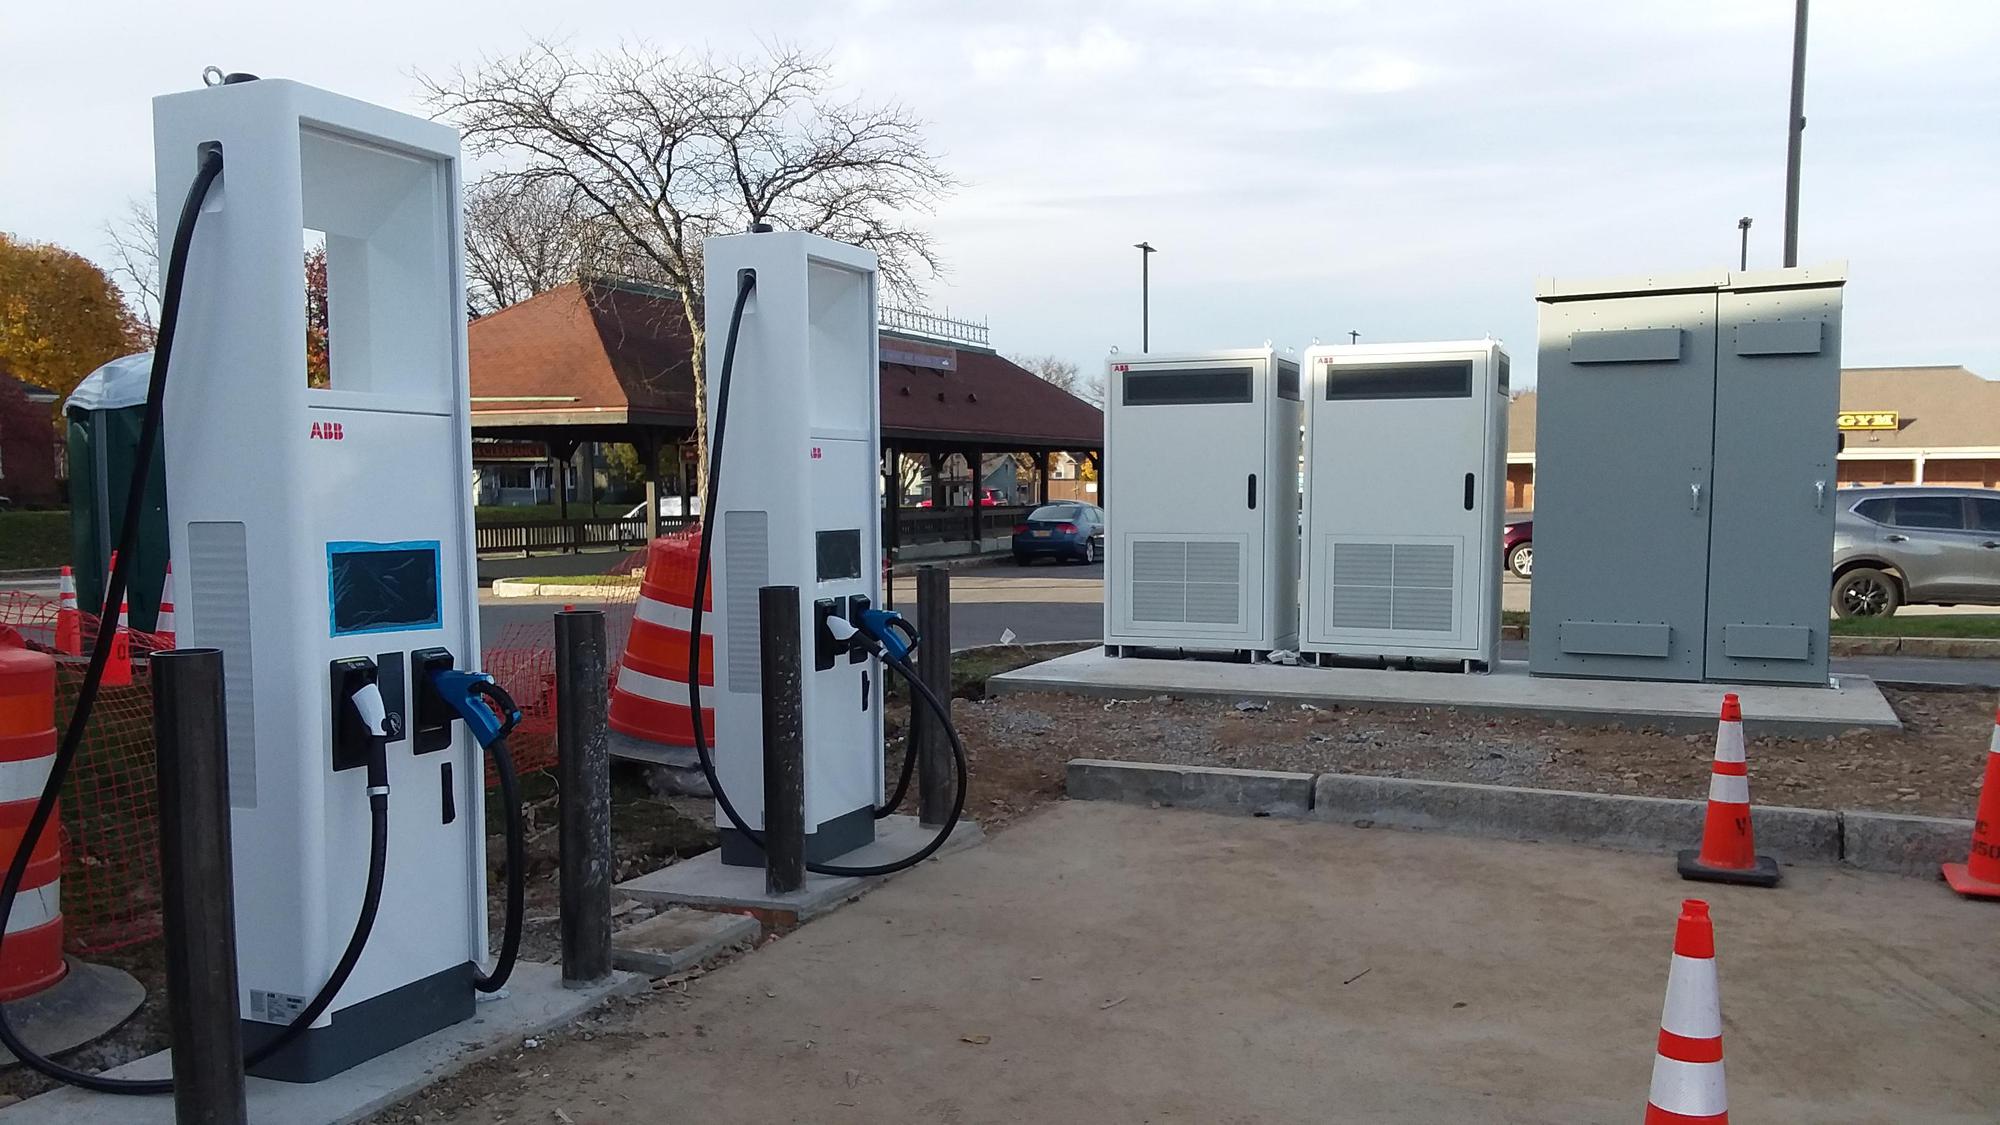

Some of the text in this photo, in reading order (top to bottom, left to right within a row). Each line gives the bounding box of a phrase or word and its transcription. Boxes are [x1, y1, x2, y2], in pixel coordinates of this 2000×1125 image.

[1317, 356, 1334, 364] ABB
[1114, 364, 1129, 372] ABB
[1837, 414, 1894, 427] GYM
[310, 421, 344, 440] ABB
